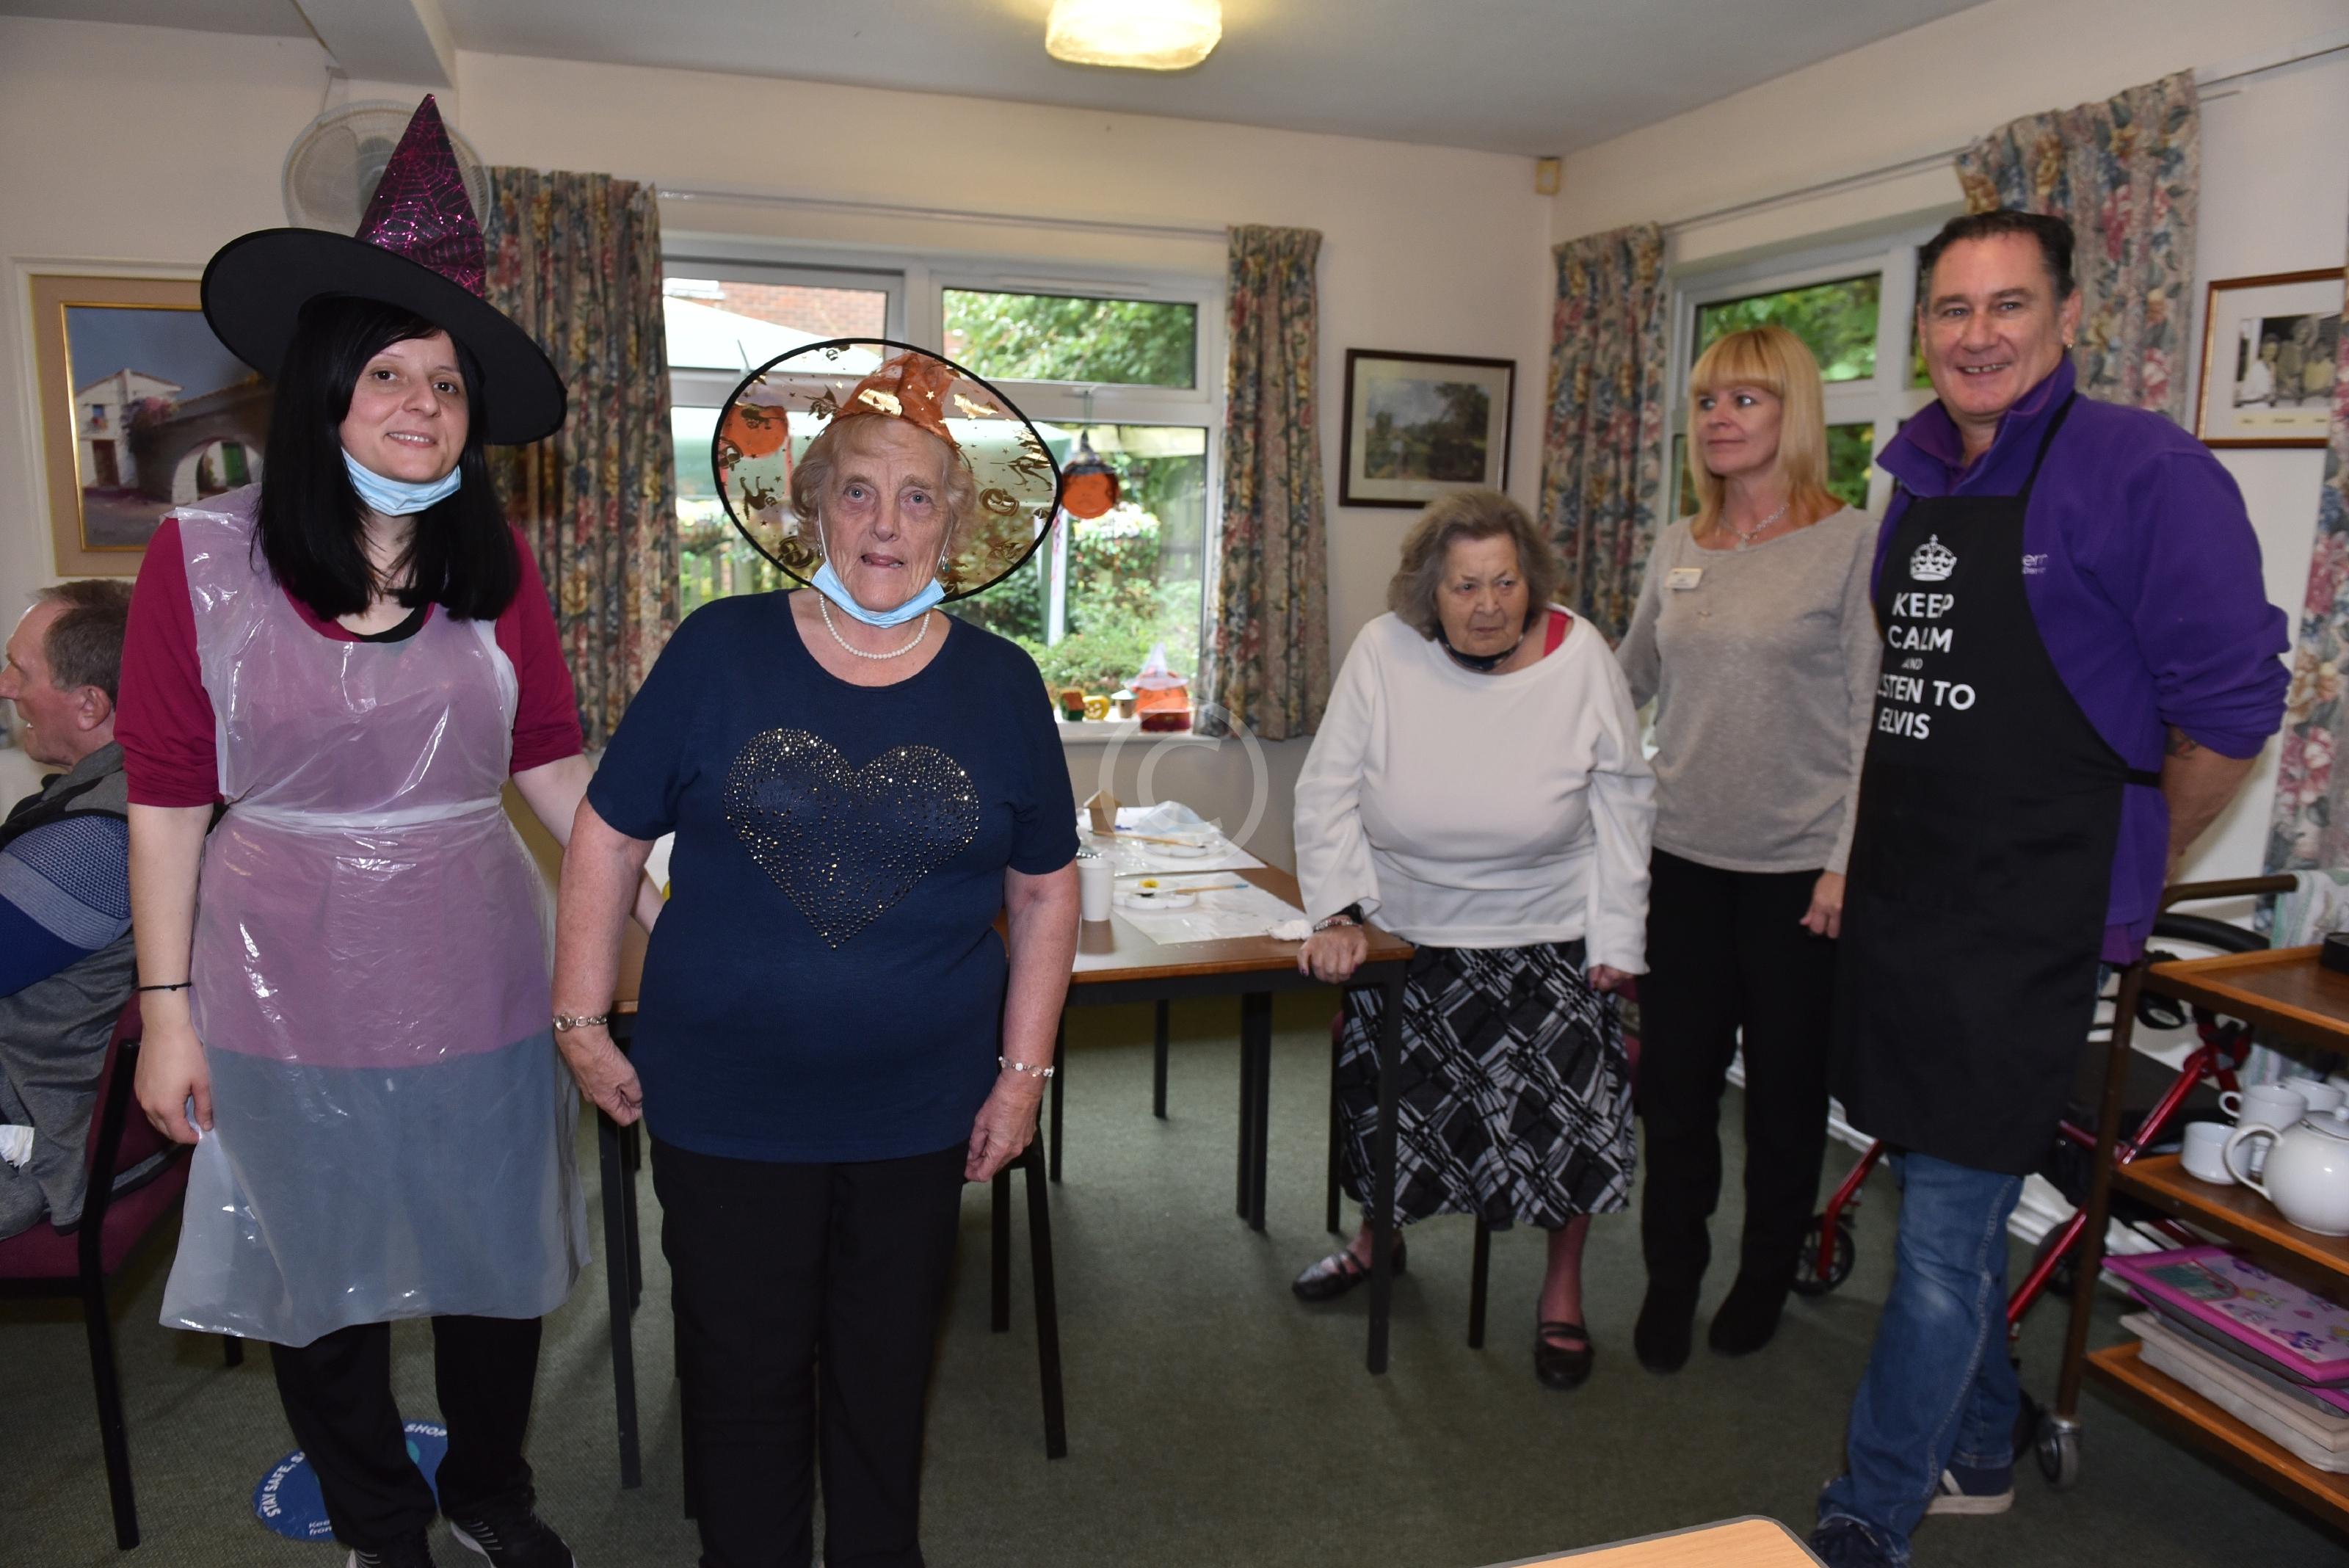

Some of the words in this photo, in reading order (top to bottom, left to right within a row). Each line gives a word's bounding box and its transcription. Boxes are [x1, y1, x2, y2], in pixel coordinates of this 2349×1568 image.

[1892, 592, 1955, 618] KEEP
[1887, 625, 1953, 653] CALM
[1901, 658, 1923, 670] AND
[1932, 680, 1976, 711] TO
[1878, 707, 1931, 740] ELVIS
[261, 1493, 282, 1517] STAY
